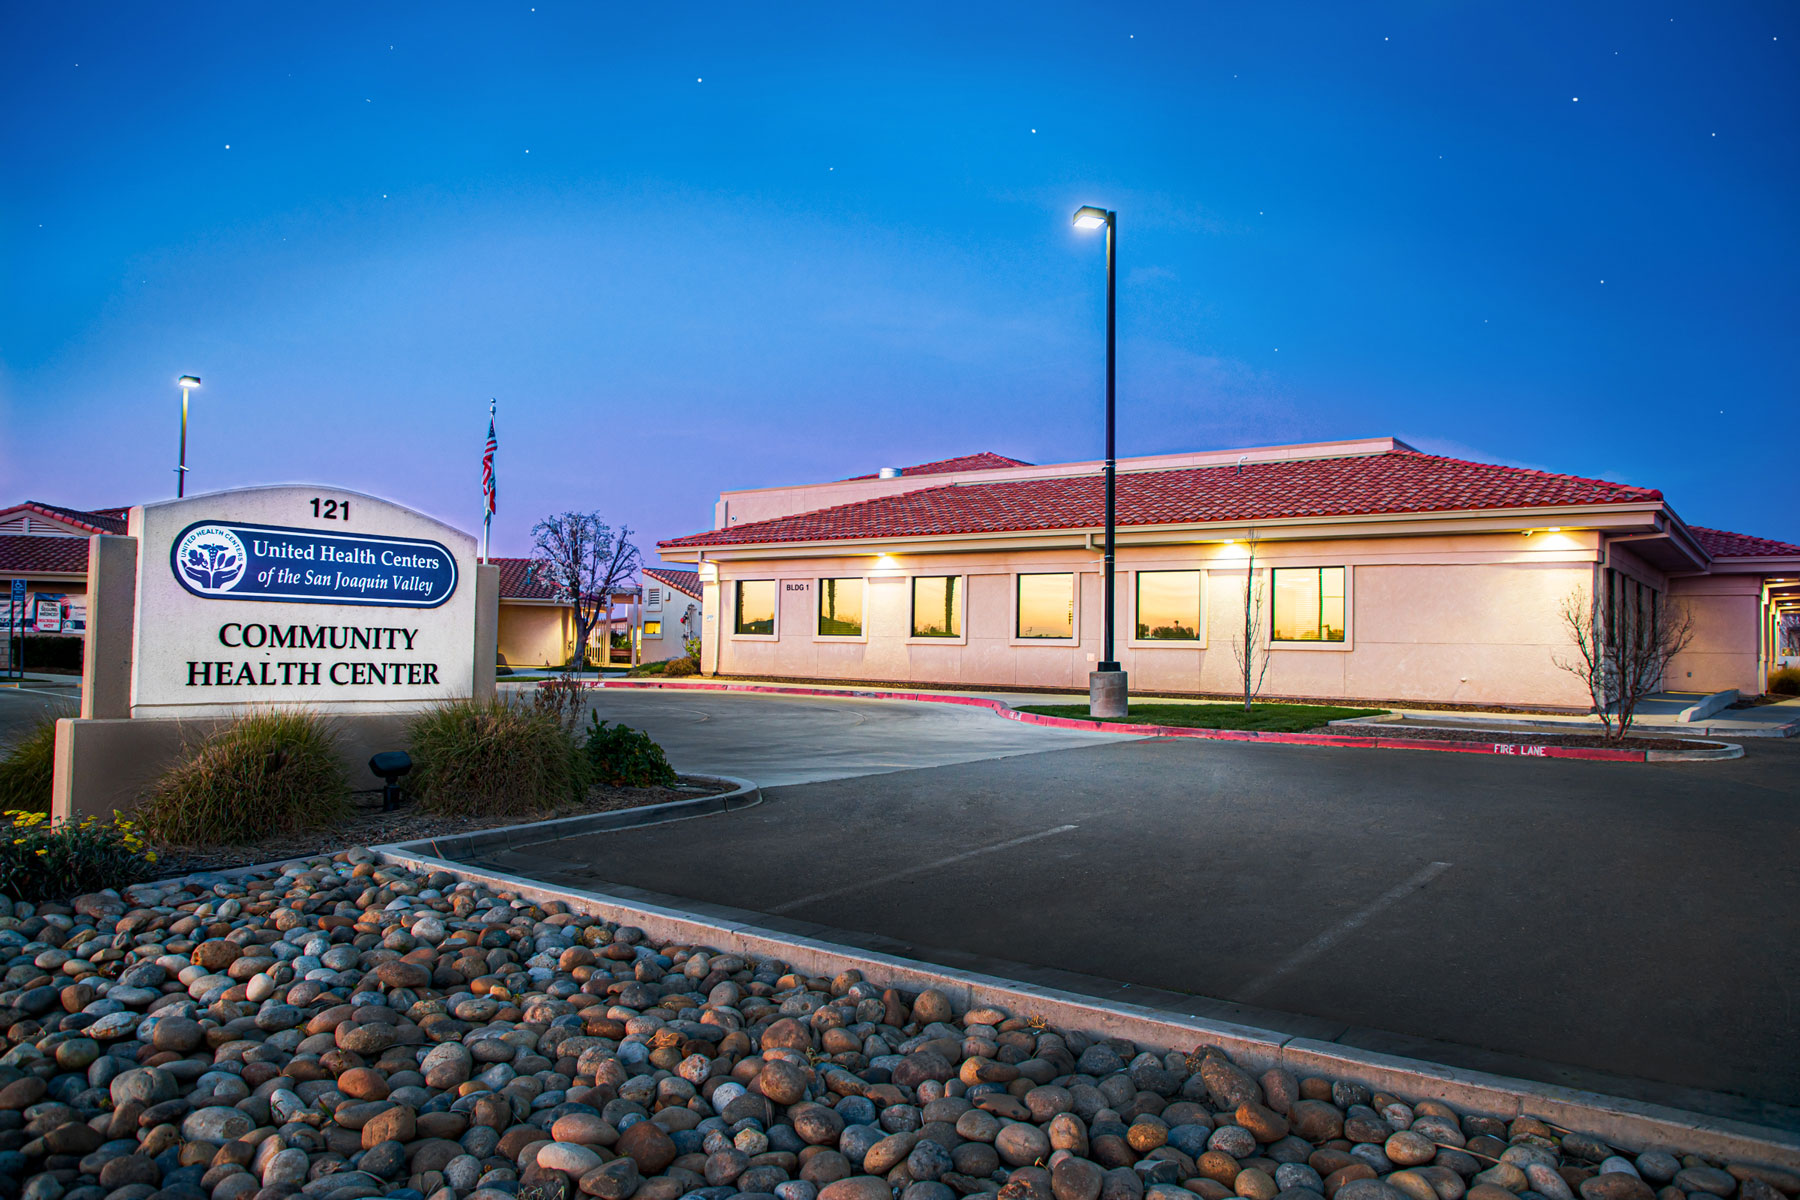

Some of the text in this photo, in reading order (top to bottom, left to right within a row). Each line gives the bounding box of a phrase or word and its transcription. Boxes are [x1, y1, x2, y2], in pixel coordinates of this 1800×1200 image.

[310, 498, 350, 521] 121
[181, 528, 243, 562] UNITED HEALTH CENTERS
[253, 540, 440, 570] United Health Centers
[257, 567, 434, 597] of the San Joaquin Valley
[218, 623, 418, 650] COMMUNITY
[186, 661, 440, 686] HEALTH CENTER
[1494, 743, 1546, 756] FIRE LANE
